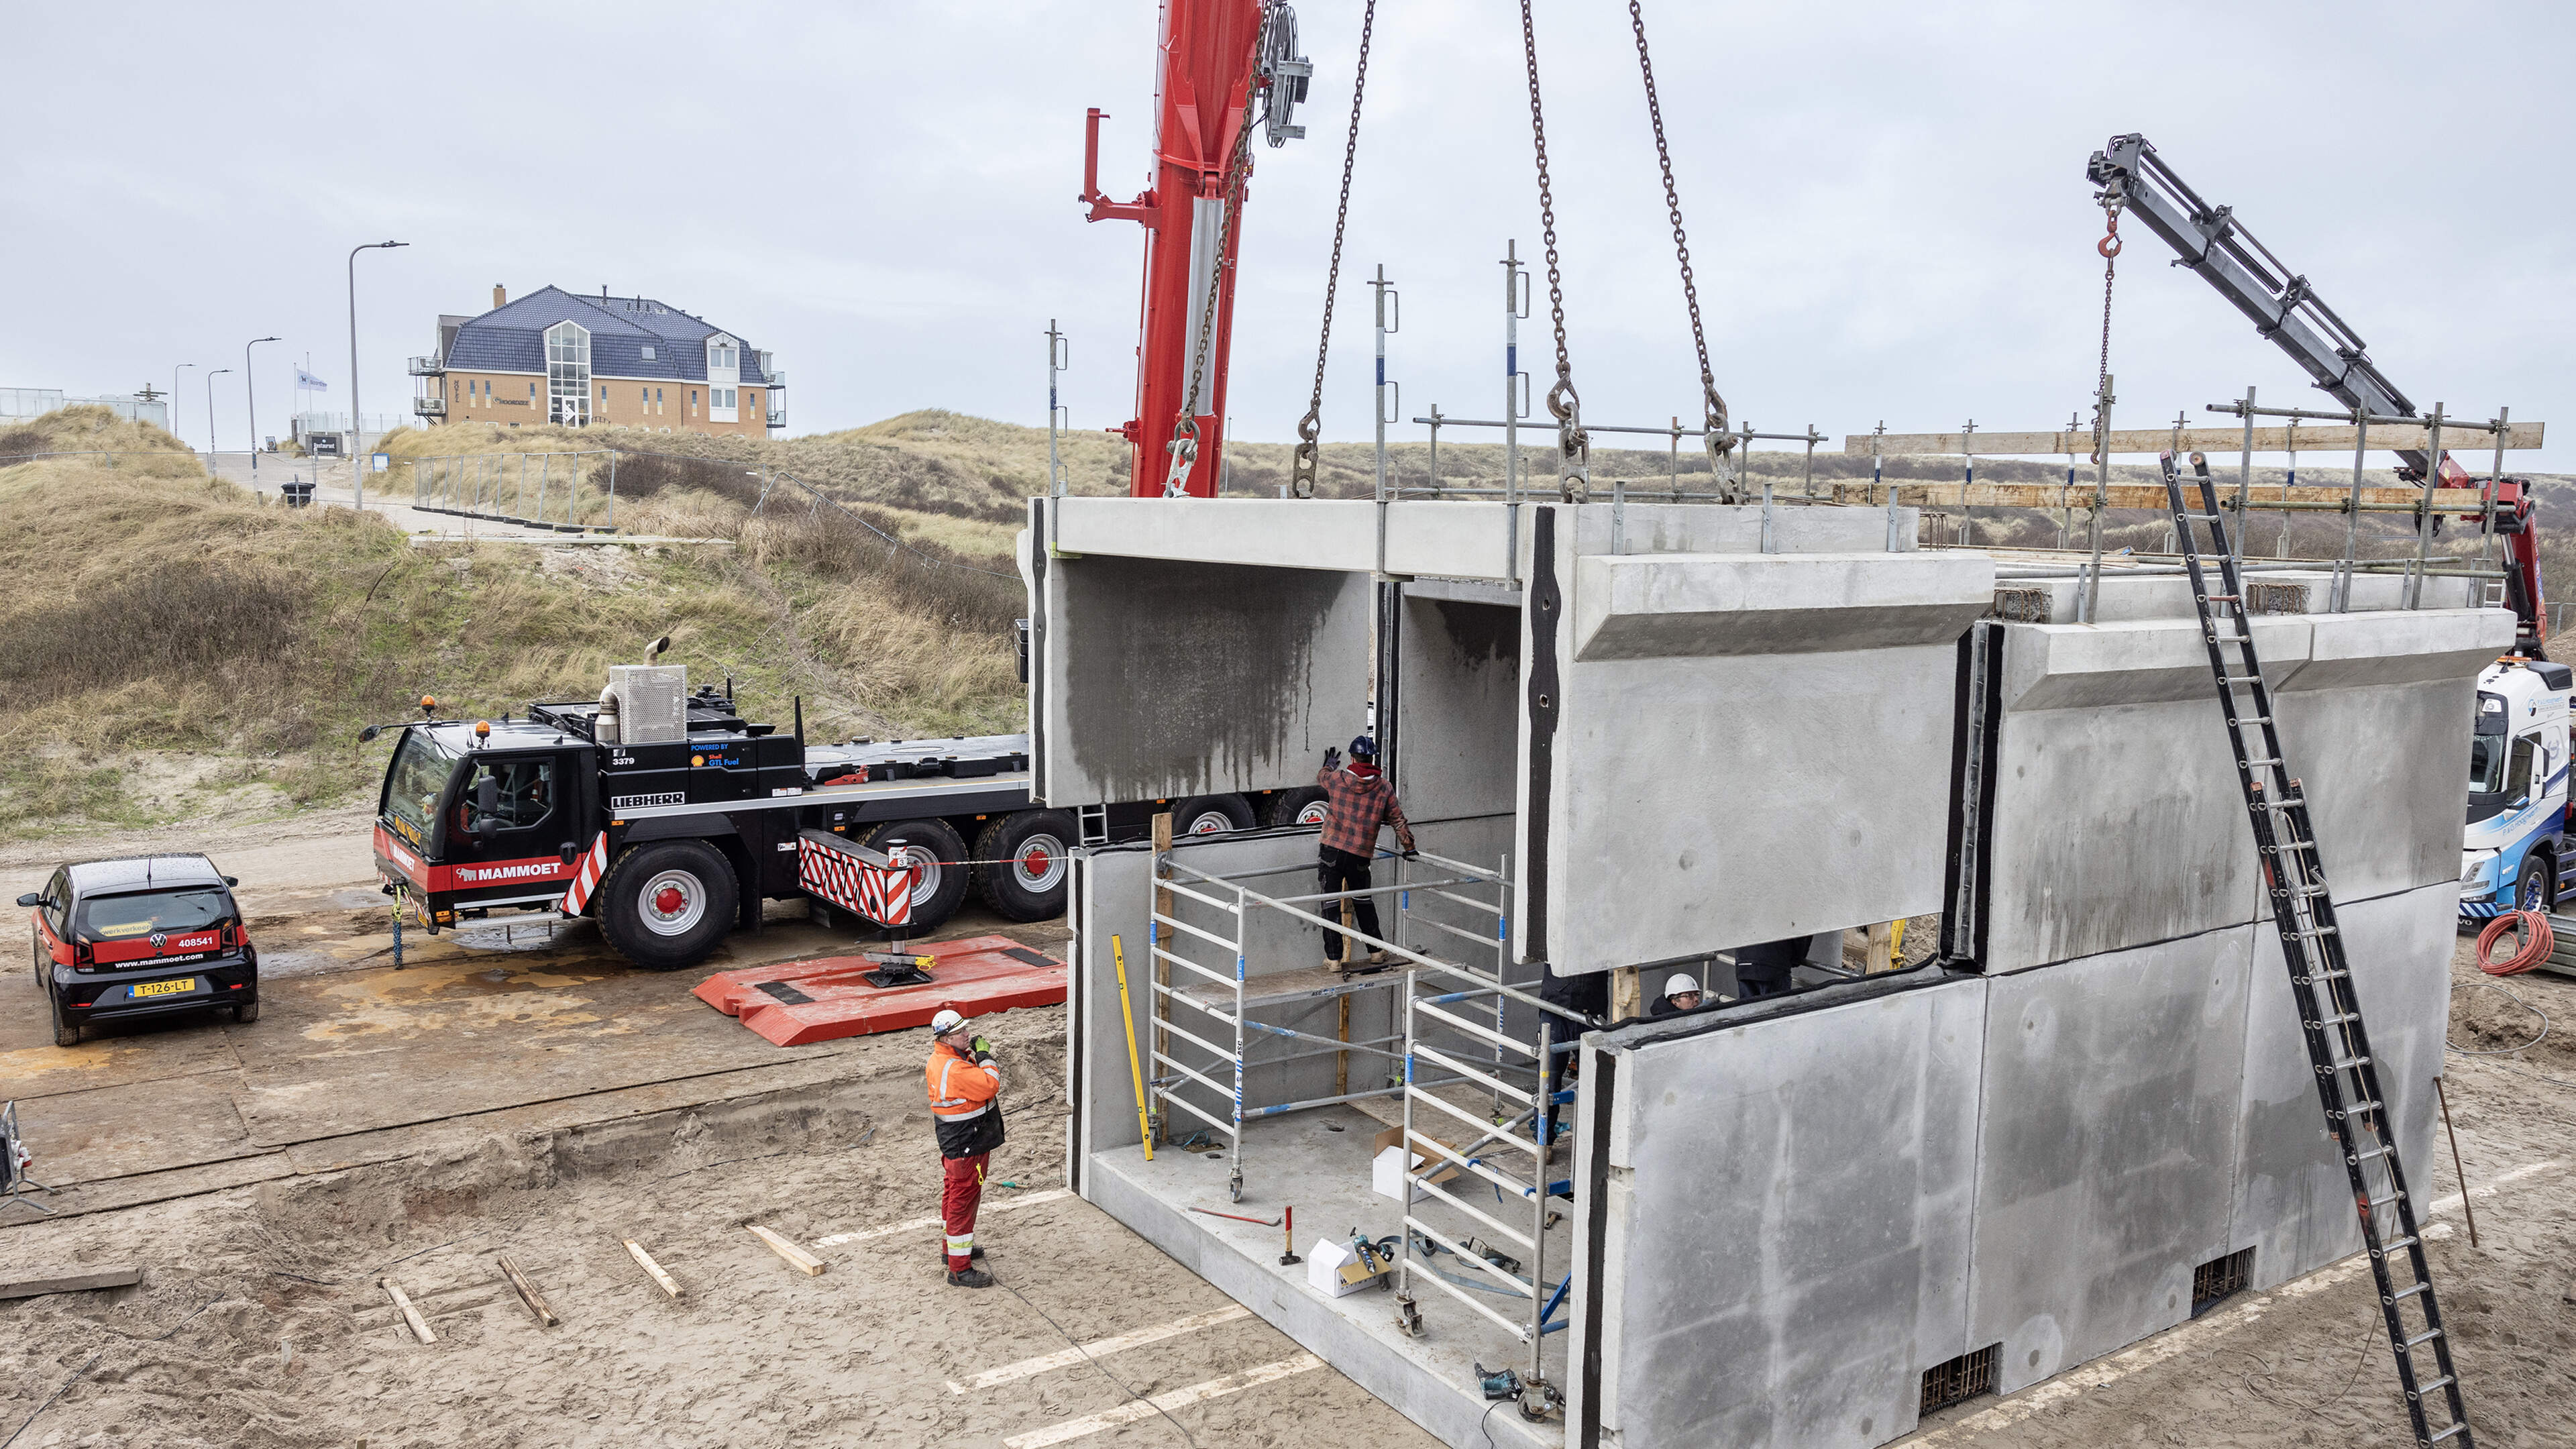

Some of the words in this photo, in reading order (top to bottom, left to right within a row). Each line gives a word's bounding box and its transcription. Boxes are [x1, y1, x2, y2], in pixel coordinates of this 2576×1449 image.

[612, 757, 635, 765] 3379
[724, 757, 739, 765] Fuel
[613, 794, 684, 808] LIEBHERR
[478, 863, 561, 880] MAMMOET
[178, 936, 213, 948] 408541
[115, 953, 203, 969] www.mammoet.com
[140, 981, 187, 994] T-126-LT
